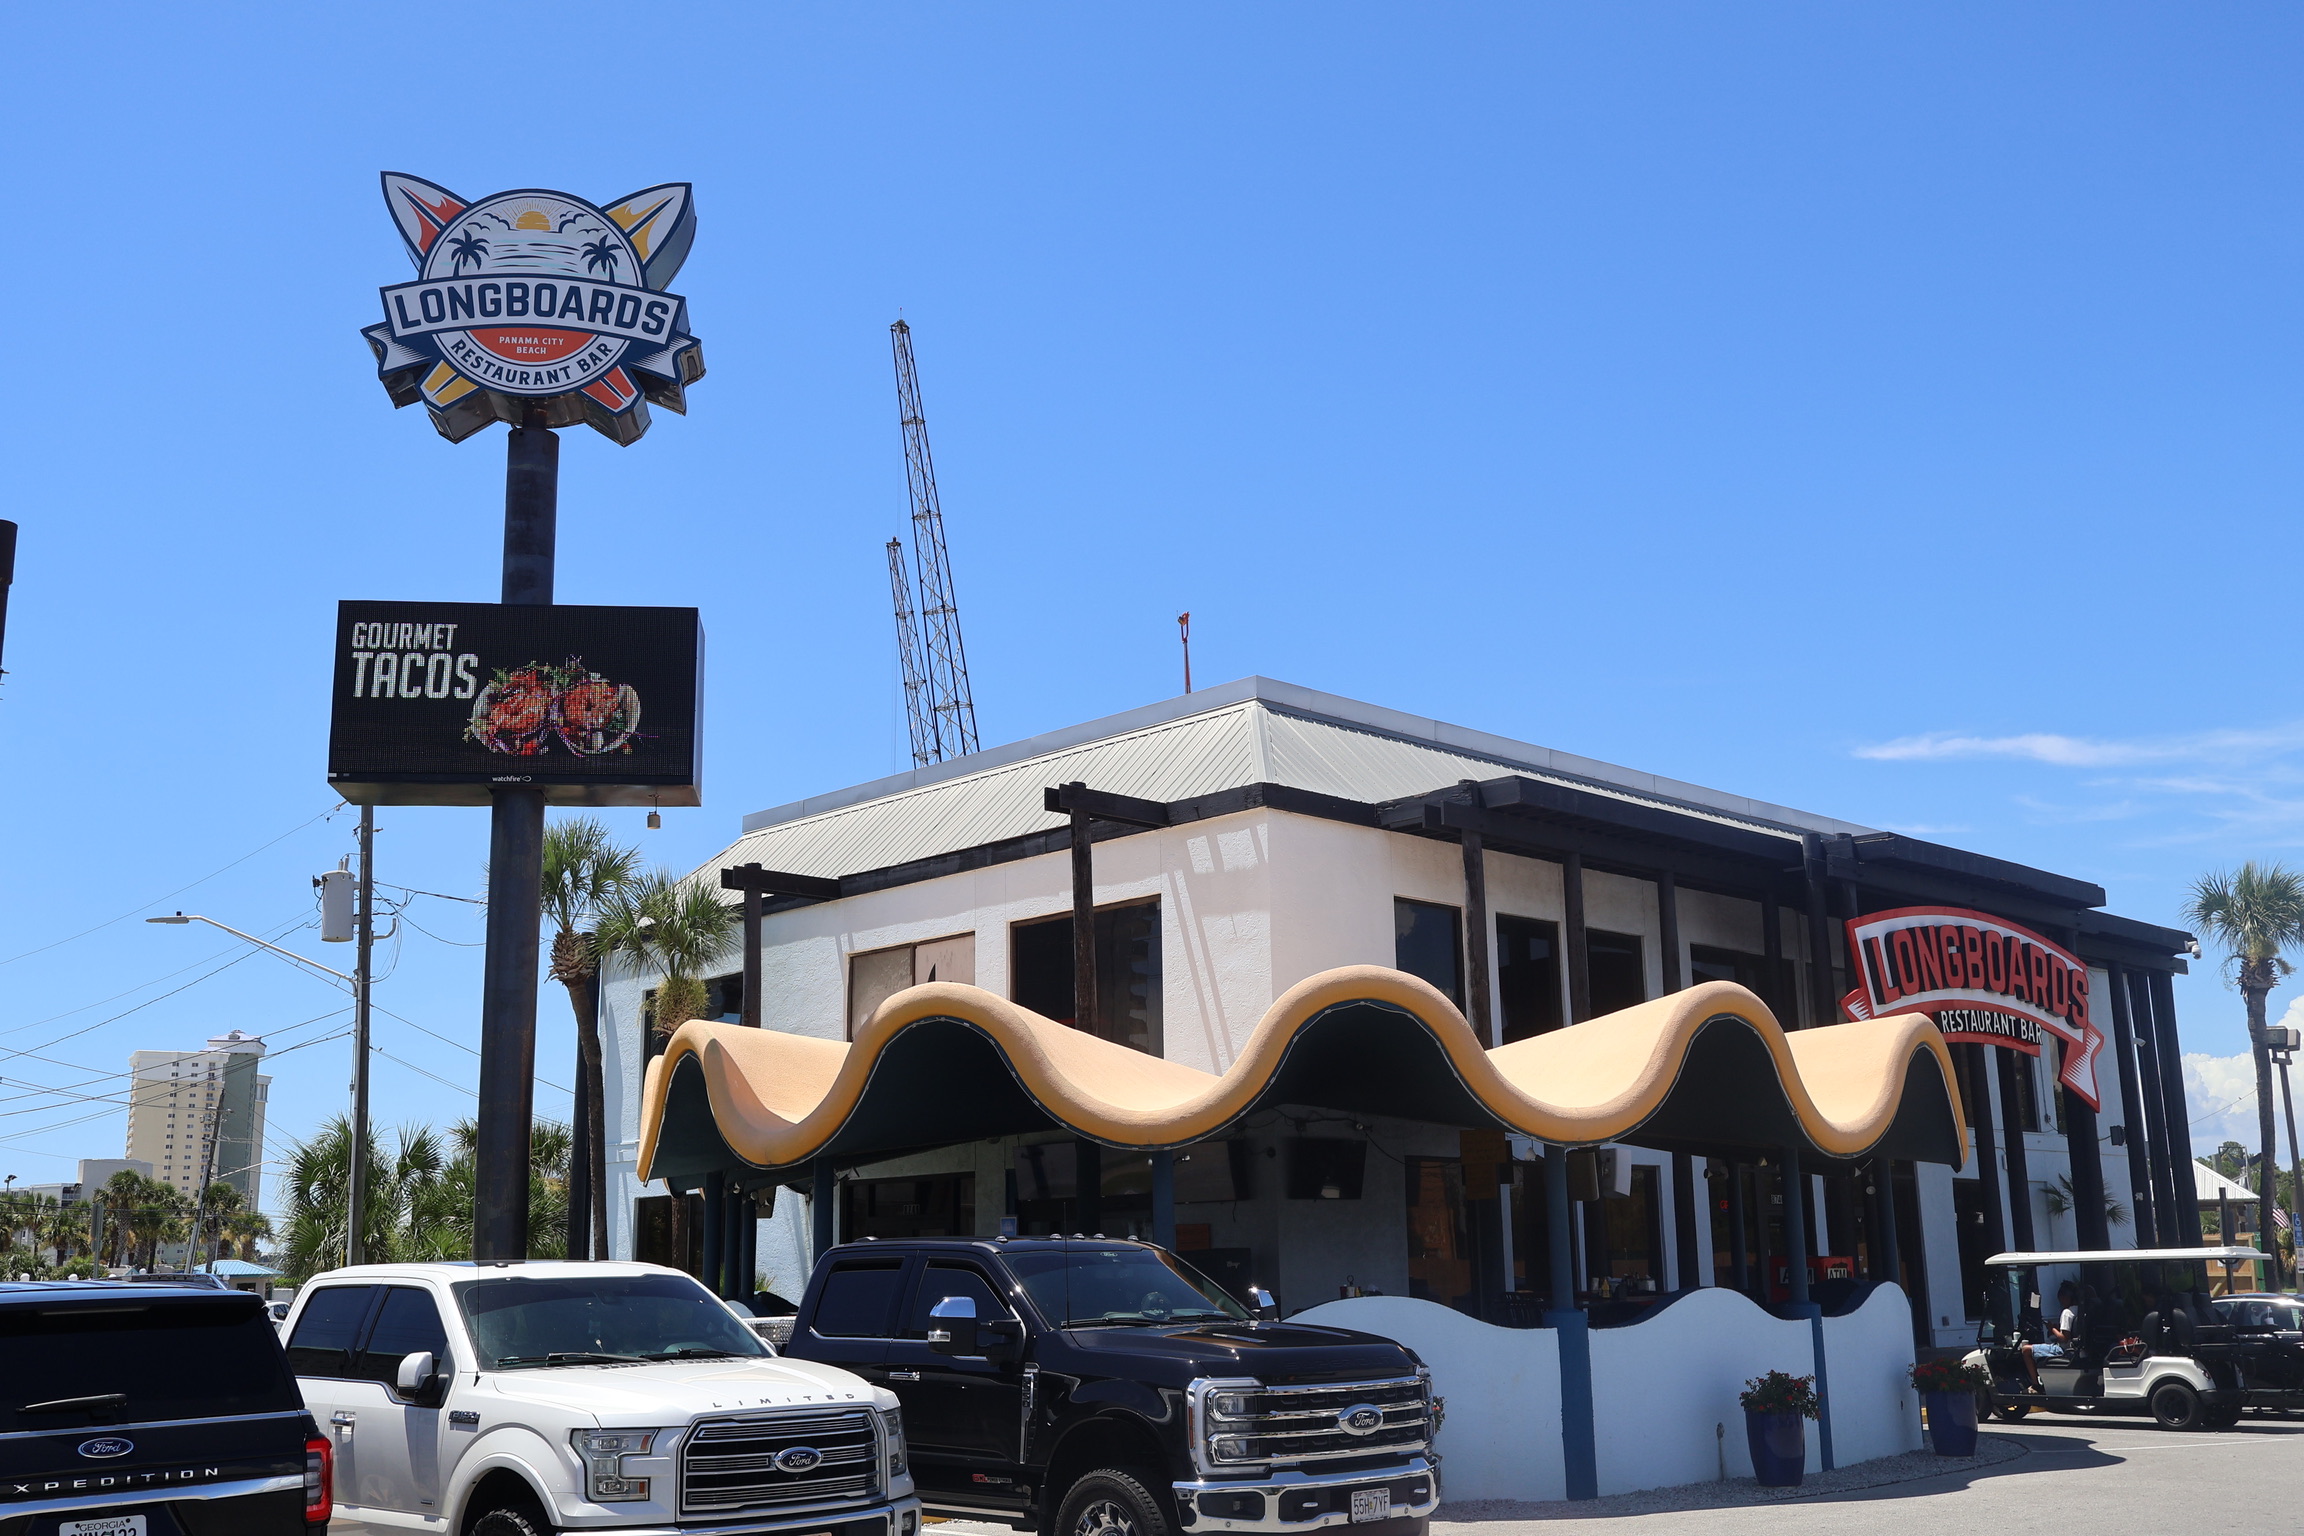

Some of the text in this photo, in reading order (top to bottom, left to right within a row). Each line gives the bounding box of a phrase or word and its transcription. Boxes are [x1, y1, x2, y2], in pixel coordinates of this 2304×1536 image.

[394, 282, 670, 335] LONGBOARDS
[499, 336, 564, 346] PANAMA CITY
[516, 346, 547, 354] BEACH
[451, 339, 613, 386] RESTAURANT BAR
[352, 622, 458, 650] GOURMET
[352, 651, 479, 699] TACOS
[1863, 924, 2089, 1029] LONGBOARDS
[1940, 1009, 2044, 1045] RESTAURANT BAR
[1829, 1268, 1847, 1279] ATM
[713, 1393, 855, 1408] LIMITED
[1354, 1412, 1376, 1427] Ford
[92, 1440, 121, 1454] Ford
[788, 1453, 812, 1467] Ford
[13, 1467, 218, 1494] XPEDITION
[80, 1520, 126, 1532] GEORGIA
